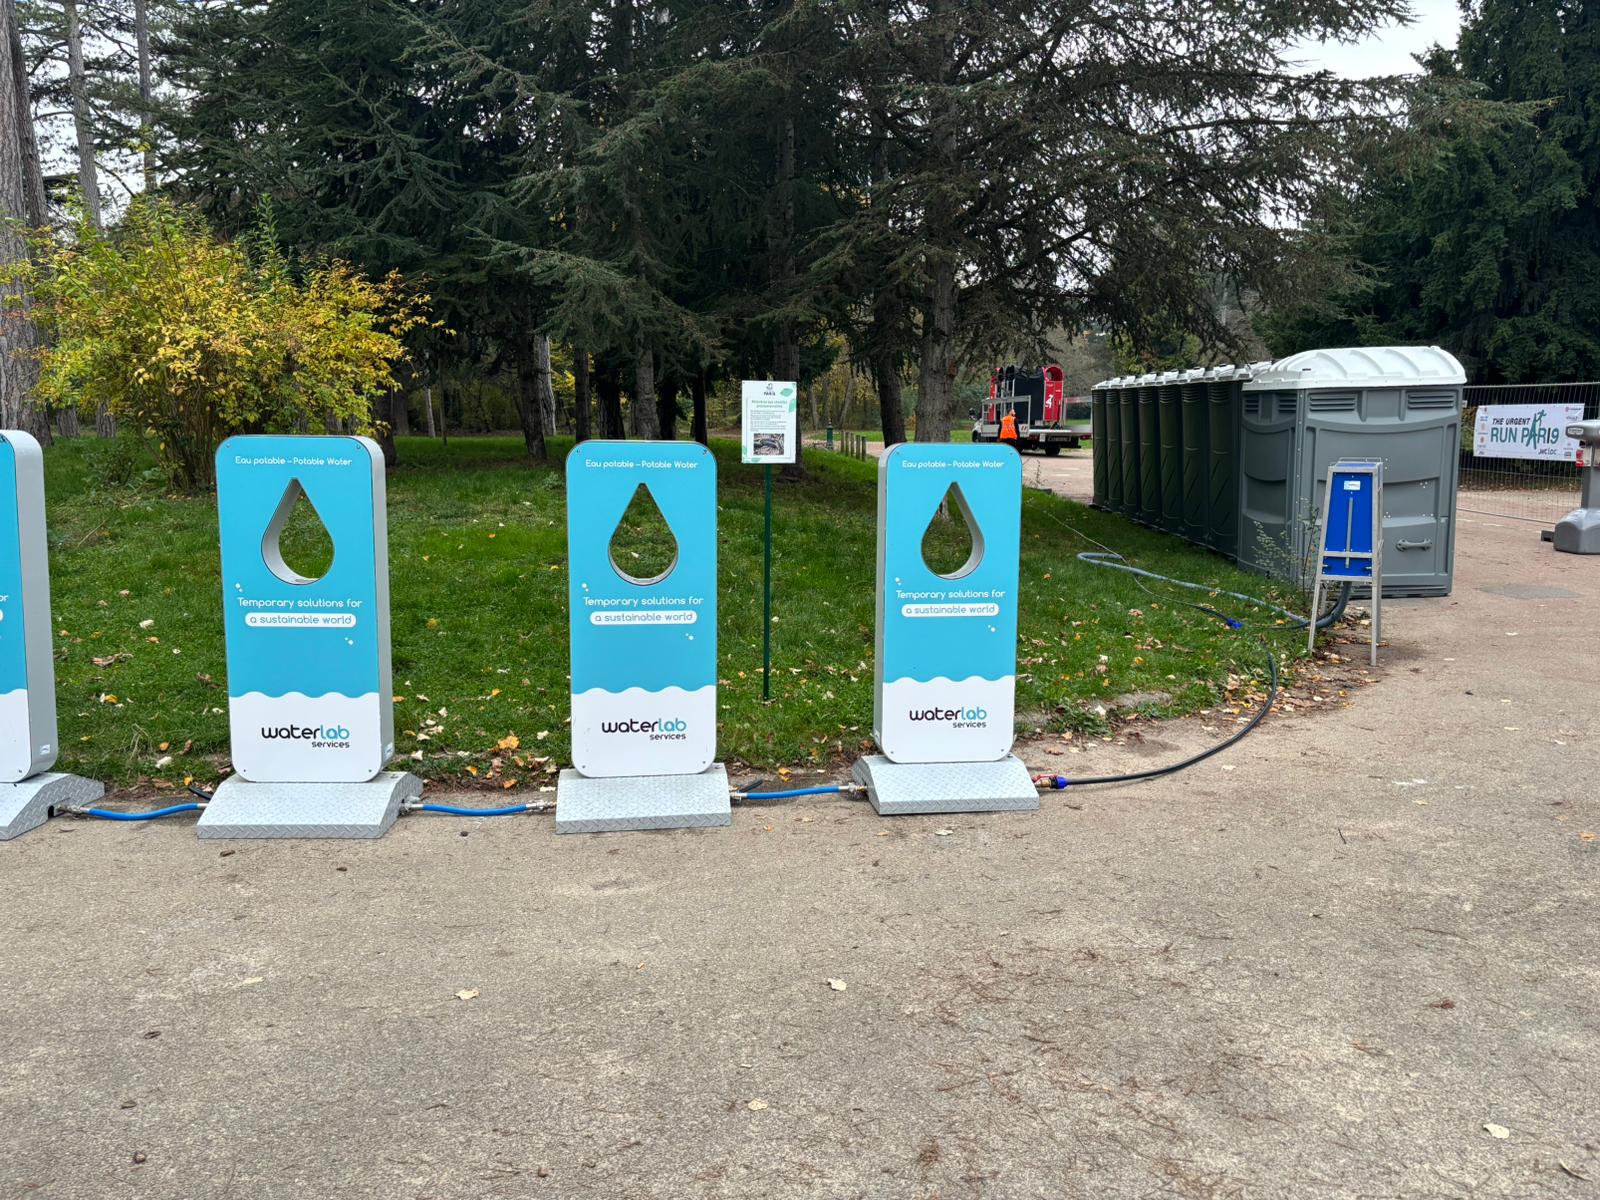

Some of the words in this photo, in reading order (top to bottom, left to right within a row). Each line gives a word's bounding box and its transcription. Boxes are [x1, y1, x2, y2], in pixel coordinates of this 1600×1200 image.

[1492, 417, 1503, 425] THE
[1505, 417, 1531, 426] URGENT
[1490, 427, 1517, 443] RUN
[235, 456, 251, 465] Eau
[253, 456, 286, 466] potable
[293, 456, 325, 465] Potable
[327, 457, 352, 466] Water
[585, 459, 601, 468] Eau
[603, 459, 635, 469] potable
[641, 460, 672, 469] Potable
[674, 460, 698, 469] Water
[902, 460, 917, 468] Eau
[918, 460, 946, 469] potable
[953, 460, 980, 468] Potable
[982, 460, 1005, 468] Water
[896, 590, 946, 600] Temporary
[948, 589, 989, 599] solutions
[991, 589, 1006, 598] for
[236, 597, 295, 608] Temporary
[297, 598, 344, 608] solutions
[346, 598, 363, 608] for
[583, 596, 639, 608] Temporary
[641, 596, 686, 606] solutions
[688, 596, 704, 605] for
[905, 607, 912, 615] a
[914, 605, 967, 614] sustainable
[969, 605, 995, 614] world
[249, 615, 257, 624] a
[259, 614, 320, 624] sustainable
[322, 615, 352, 625] world
[604, 613, 662, 622] sustainable
[665, 612, 693, 622] world
[909, 706, 988, 721] waterlab
[601, 717, 687, 733] waterlab
[952, 721, 987, 729] services
[261, 724, 350, 740] waterlab
[649, 732, 687, 741] services
[311, 741, 350, 749] services
